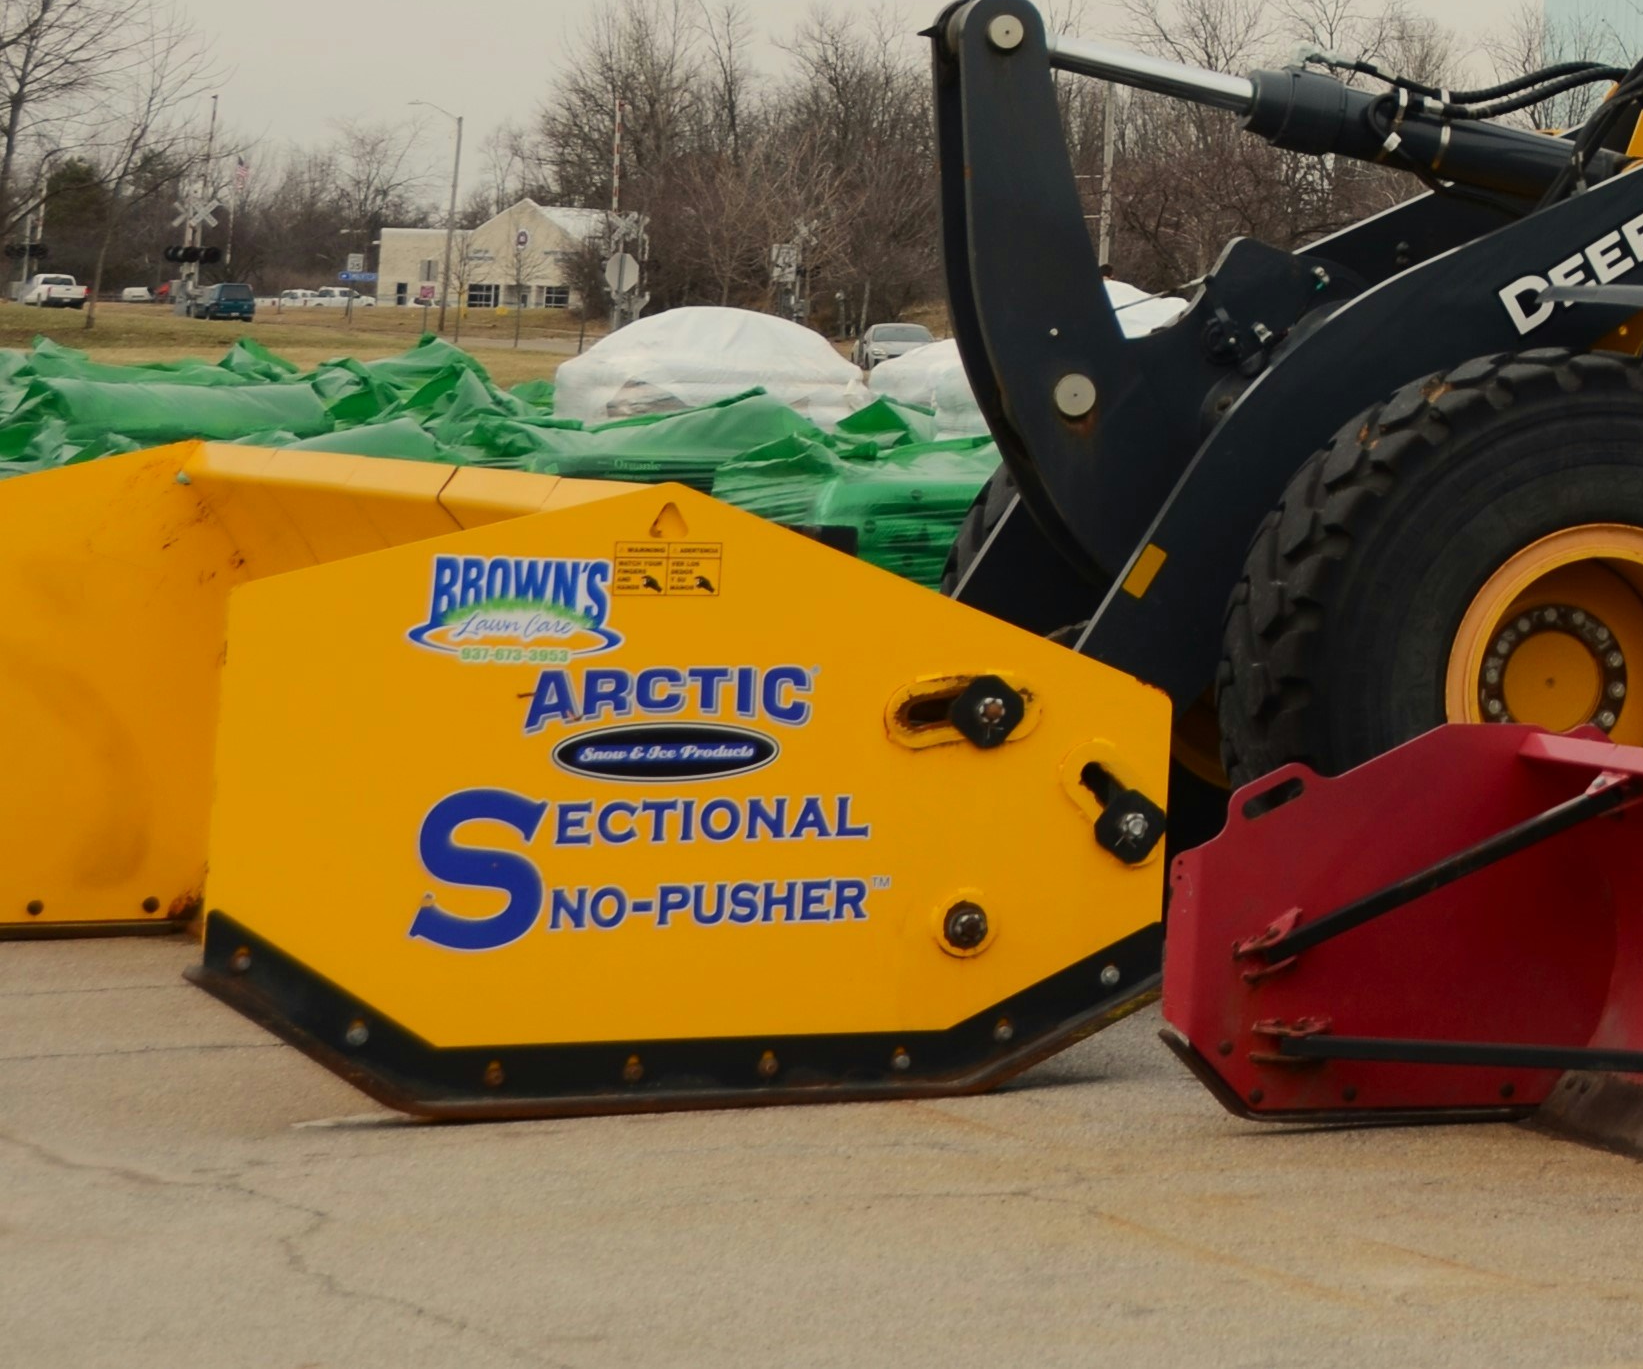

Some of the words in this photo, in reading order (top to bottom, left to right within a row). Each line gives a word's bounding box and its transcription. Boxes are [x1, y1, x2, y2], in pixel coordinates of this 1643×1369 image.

[430, 556, 610, 629] BROWN'S
[453, 612, 520, 637] Lawn
[523, 613, 574, 638] Care
[525, 666, 811, 731] ARCTIC
[579, 746, 627, 761] Snow
[629, 745, 644, 759] &
[645, 745, 676, 759] Ice
[680, 744, 754, 759] Products
